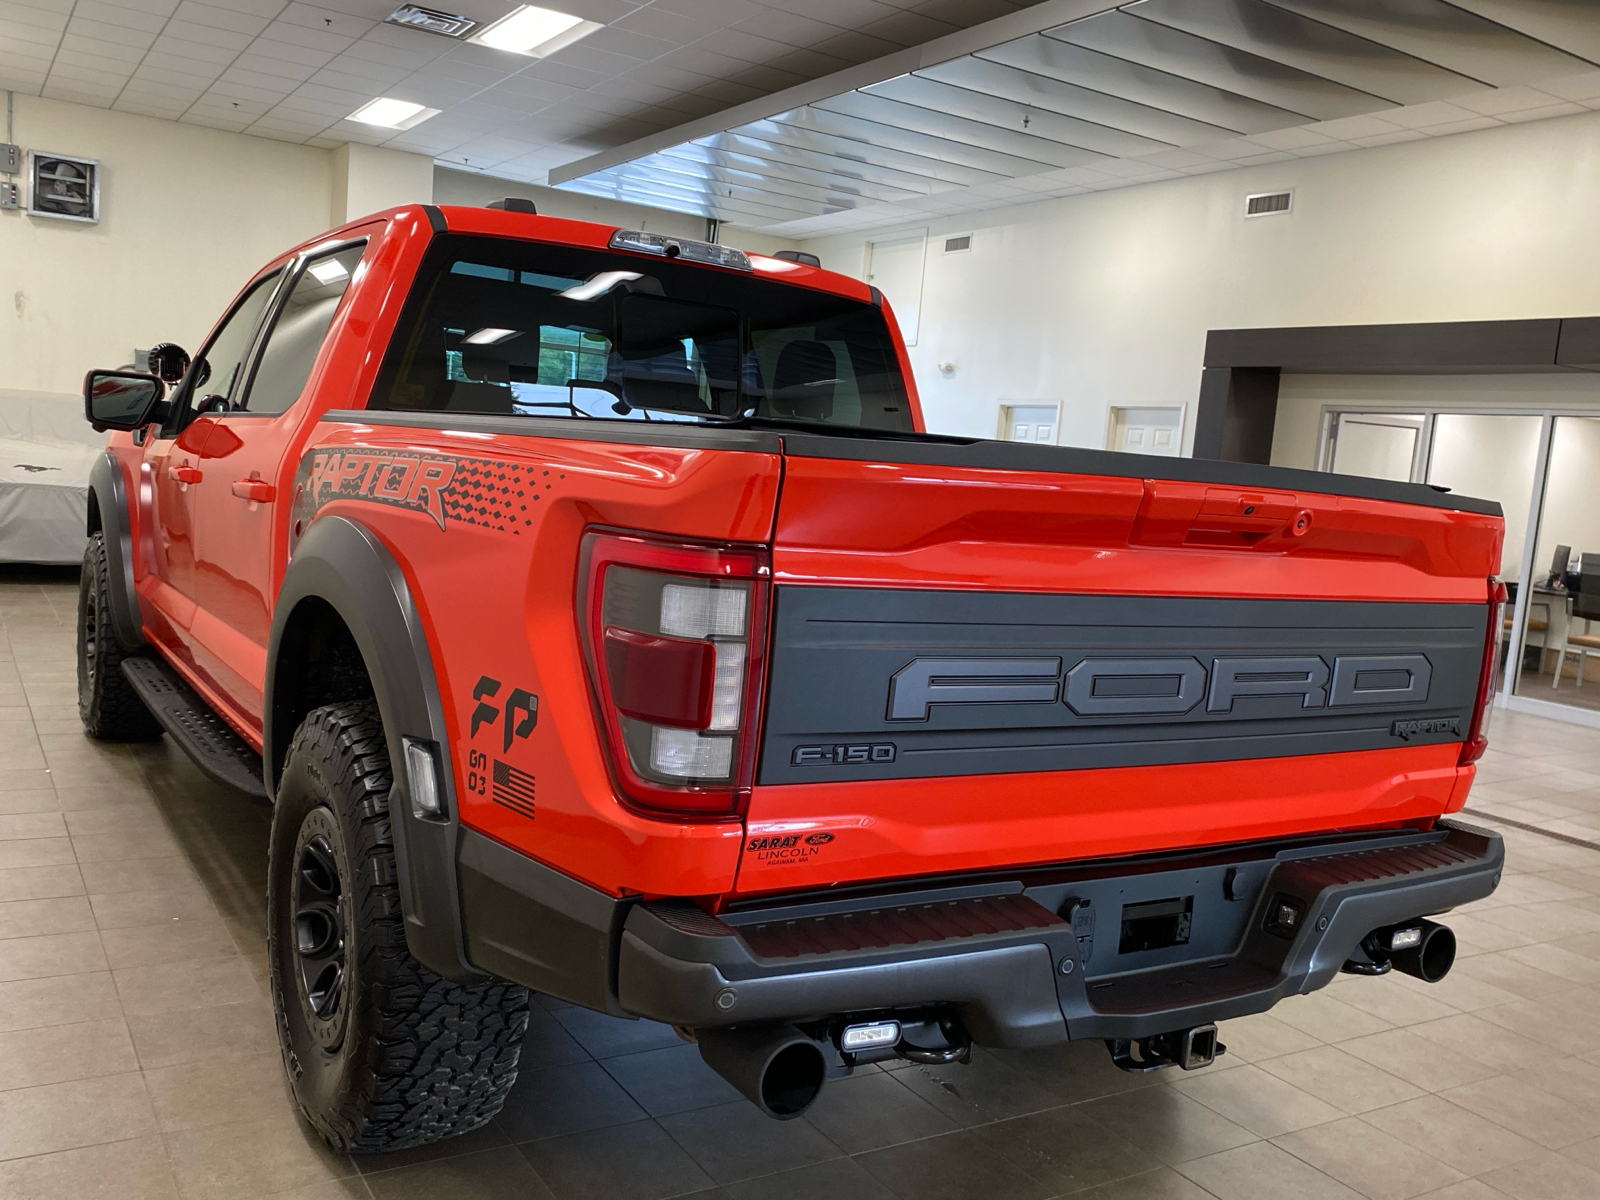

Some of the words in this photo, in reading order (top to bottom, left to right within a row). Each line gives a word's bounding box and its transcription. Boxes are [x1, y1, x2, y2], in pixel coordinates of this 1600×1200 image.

[305, 453, 456, 532] RAPTOR
[886, 653, 1433, 722] FORD
[471, 675, 539, 754] FP
[1391, 717, 1460, 740] RAPTOR
[791, 743, 896, 766] F-150
[747, 835, 802, 851] SARAT
[807, 833, 833, 845] Ford
[758, 847, 819, 860] LINCOLN
